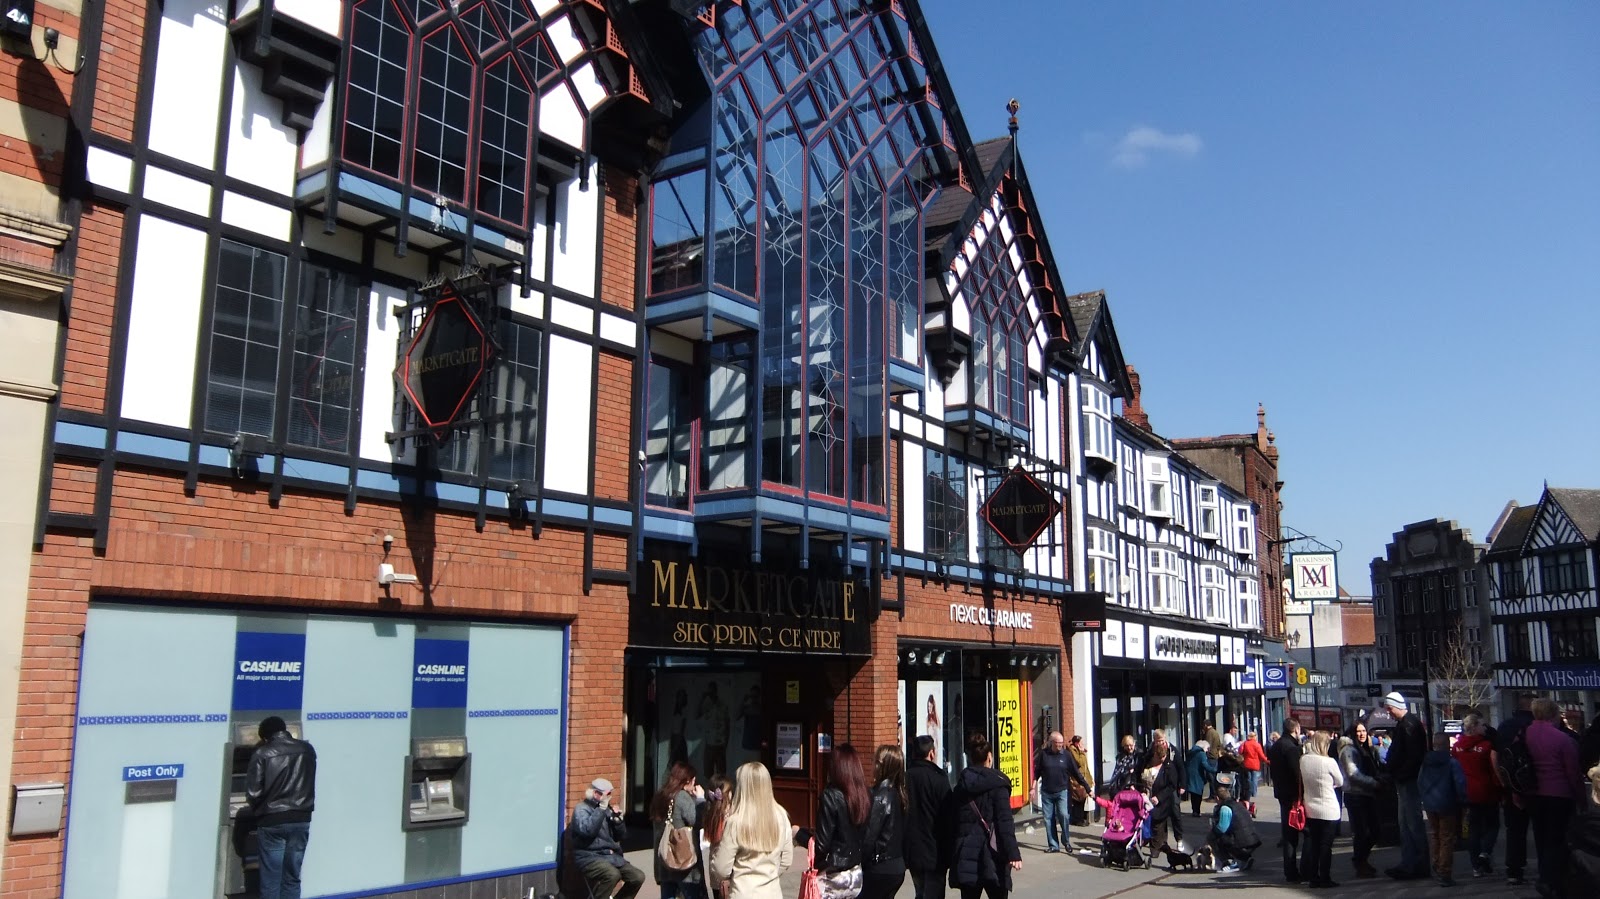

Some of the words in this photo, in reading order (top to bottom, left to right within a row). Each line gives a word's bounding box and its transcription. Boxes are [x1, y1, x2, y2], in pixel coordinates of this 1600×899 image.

[6, 8, 29, 25] 4A
[412, 347, 478, 375] MARKETGATE
[992, 504, 1046, 516] MARKETGATE
[651, 559, 855, 623] MARKETGATE
[950, 603, 977, 624] next
[978, 607, 1032, 629] CLEARANCE
[673, 621, 773, 646] SHOPPING
[779, 628, 841, 649] CENTRE
[240, 660, 302, 673] CASHLINE
[417, 664, 466, 675] CASHLINE
[1542, 670, 1600, 687] WHSmith
[1008, 700, 1017, 710] TO
[1000, 740, 1016, 753] OFF
[128, 768, 152, 778] Post
[155, 766, 179, 777] Only
